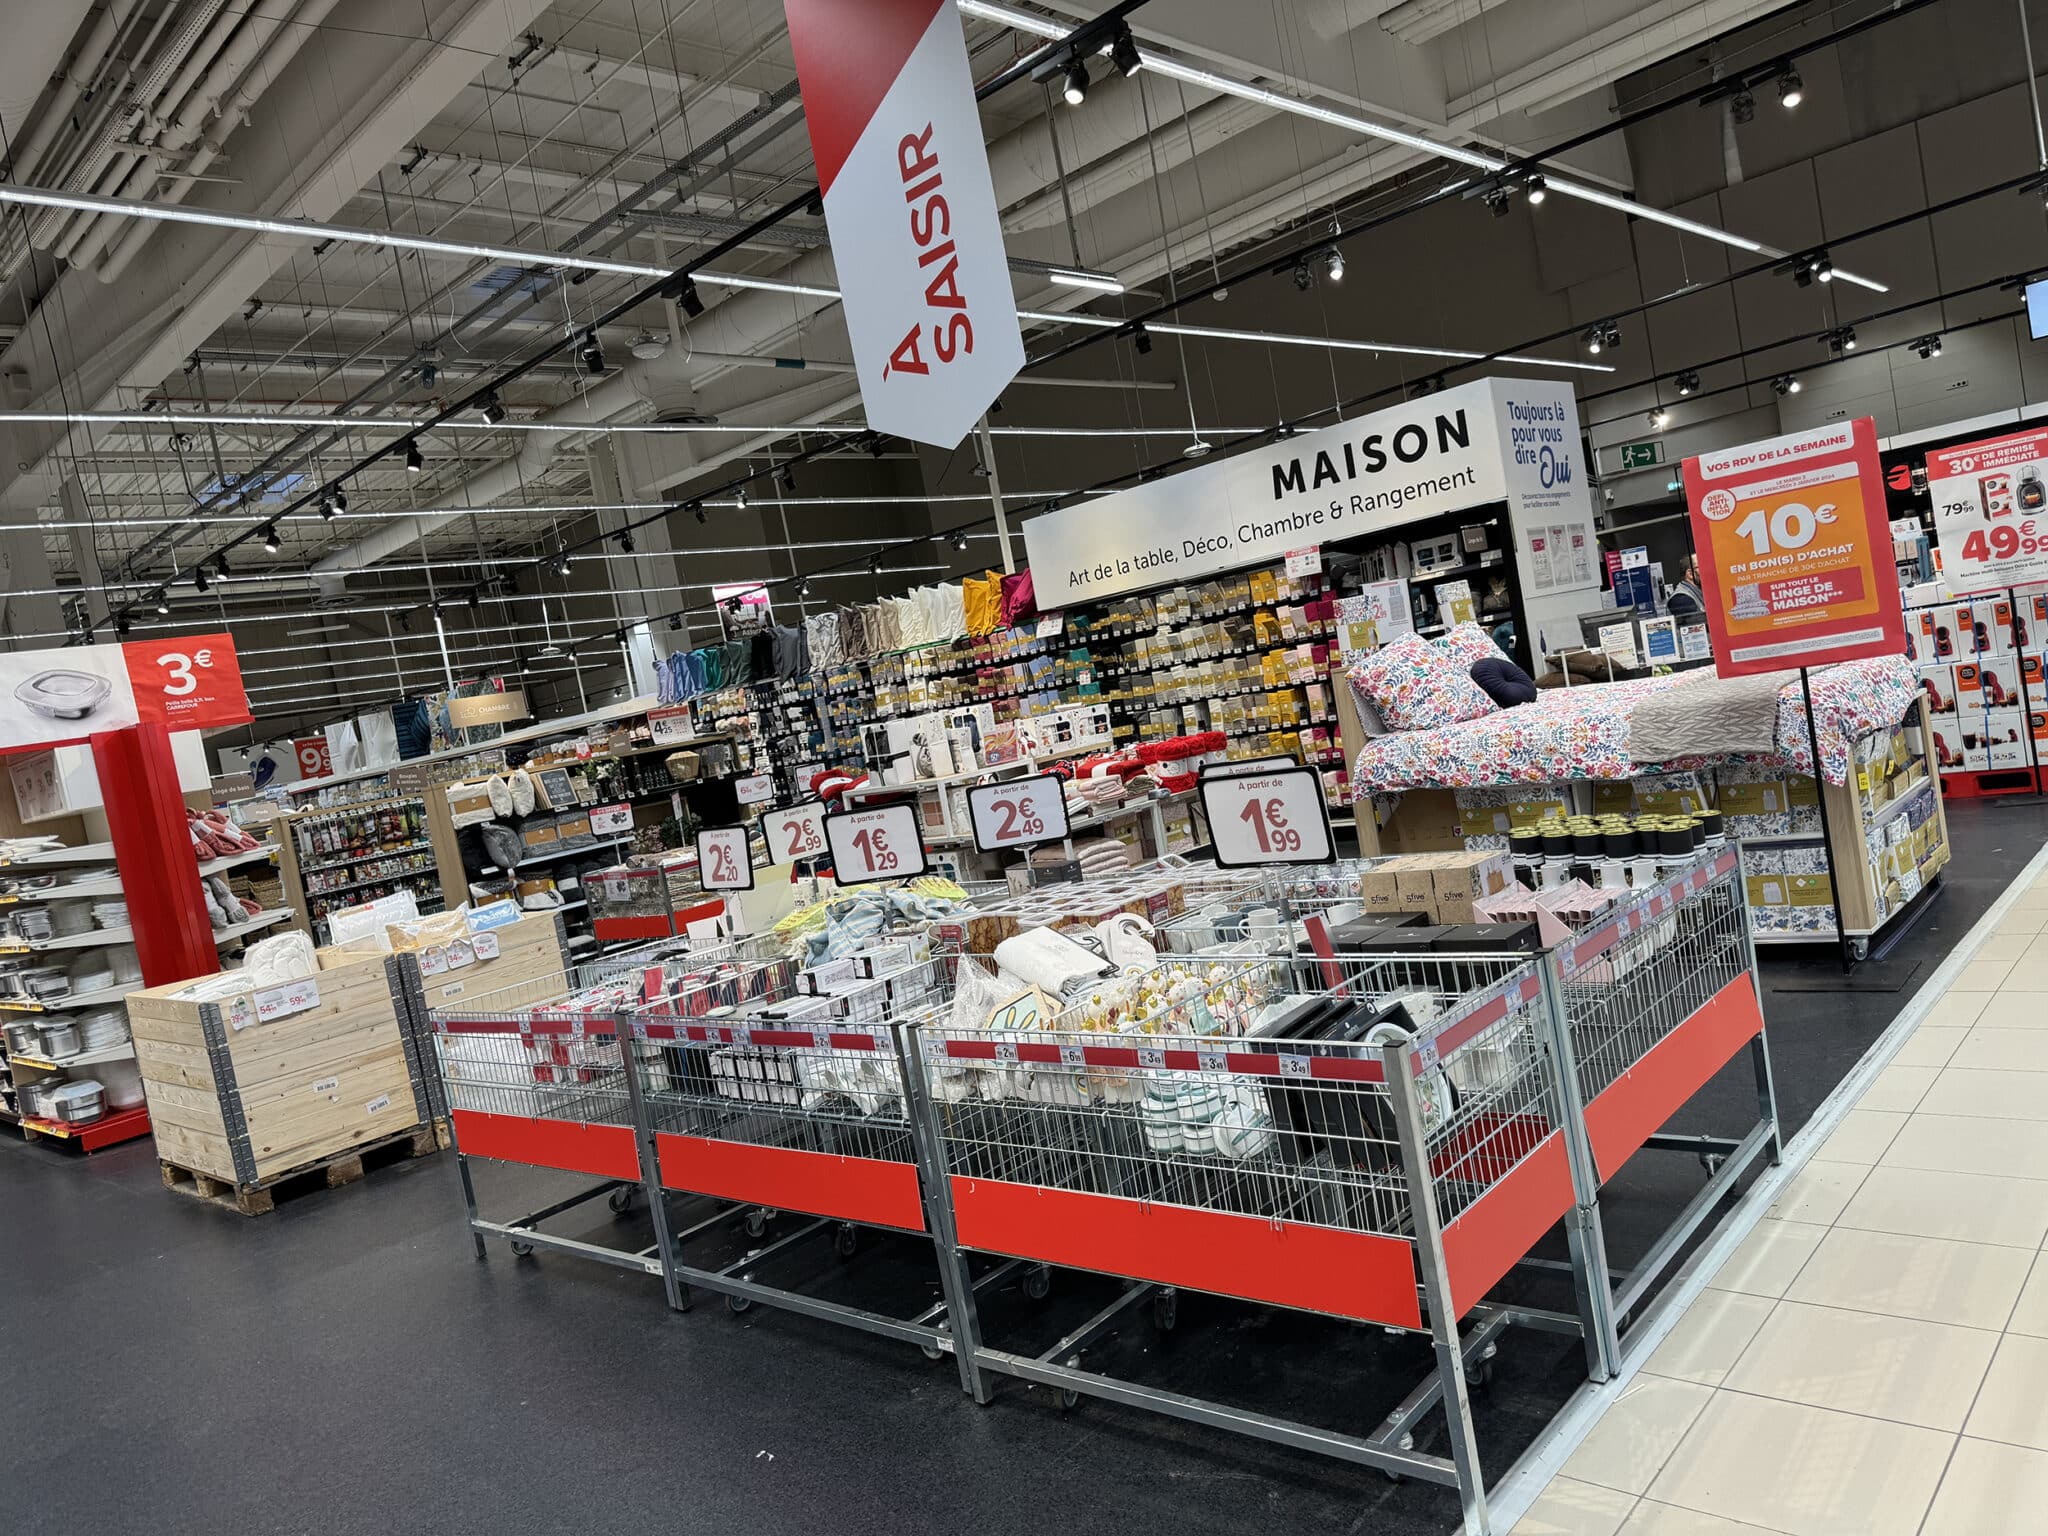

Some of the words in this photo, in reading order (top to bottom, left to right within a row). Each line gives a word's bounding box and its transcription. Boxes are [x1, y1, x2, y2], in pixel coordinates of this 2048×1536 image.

[898, 121, 974, 364] SAISIR
[883, 322, 930, 382] À
[1507, 401, 1553, 424] Toujours
[1554, 402, 1565, 421] là
[1511, 427, 1536, 446] pour
[1538, 427, 1563, 443] vous
[1272, 409, 1470, 500] MAISON
[1515, 445, 1537, 465] dire
[1707, 460, 1730, 473] VOS
[1733, 455, 1755, 467] RDV
[1759, 451, 1774, 462] DE
[1777, 448, 1791, 458] LA
[1794, 435, 1847, 454] SEMAINE
[1981, 451, 1995, 460] DE
[1997, 443, 2035, 457] REMISE
[1539, 445, 1572, 489] Oui
[1069, 571, 1090, 587] Art
[1094, 564, 1113, 580] de
[1116, 559, 1130, 575] la
[1134, 548, 1178, 571] table,
[1183, 535, 1233, 558] Déco,
[1238, 509, 1324, 543] Chambre
[1330, 501, 1343, 519] &
[1351, 466, 1476, 514] Rangement
[1730, 564, 1747, 574] EN
[1750, 555, 1794, 571] BON(S)
[1797, 544, 1854, 561] D'ACHAT
[1753, 569, 1786, 580] TRANCHE
[1771, 586, 1811, 601] LINGE
[1814, 582, 1834, 593] DE
[212, 787, 228, 795] Linge
[1001, 785, 1019, 795] partir
[1020, 783, 1030, 791] de
[1247, 779, 1270, 791] partir
[1272, 778, 1283, 787] de
[857, 814, 875, 824] partir
[876, 813, 885, 821] de
